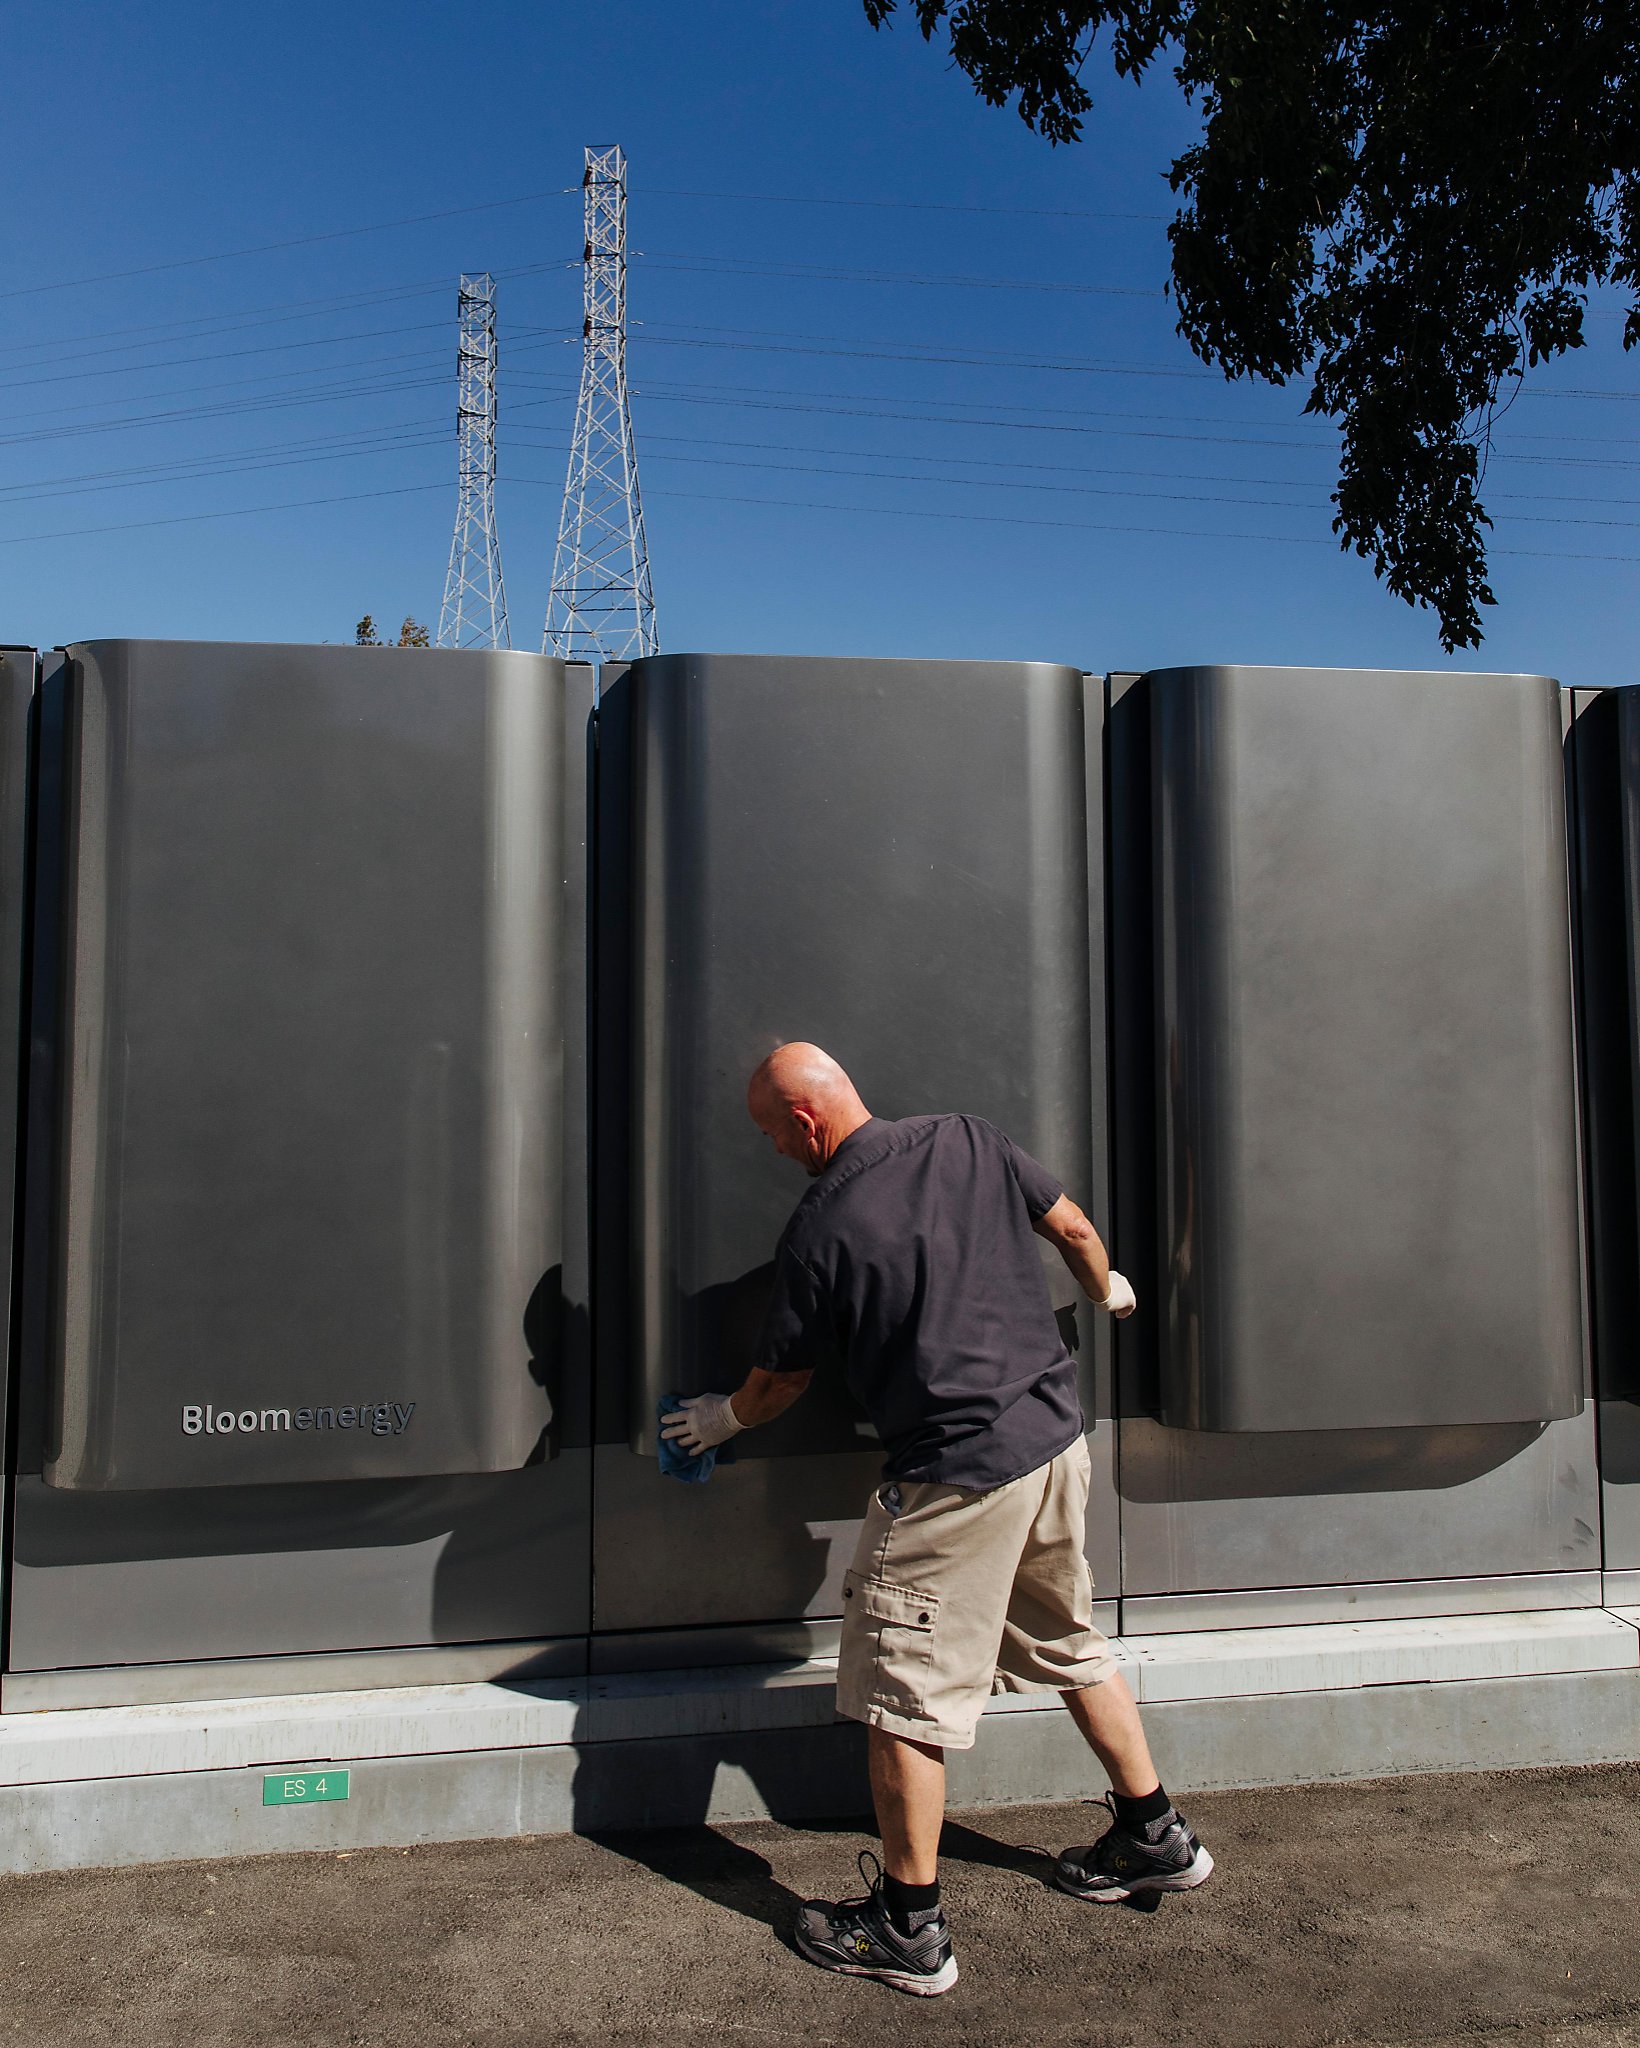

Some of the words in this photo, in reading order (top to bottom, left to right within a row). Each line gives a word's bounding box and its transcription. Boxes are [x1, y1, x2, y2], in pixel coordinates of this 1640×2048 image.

[182, 1402, 416, 1435] Bloomenergy
[284, 1779, 306, 1798] ES
[315, 1777, 328, 1794] 4
